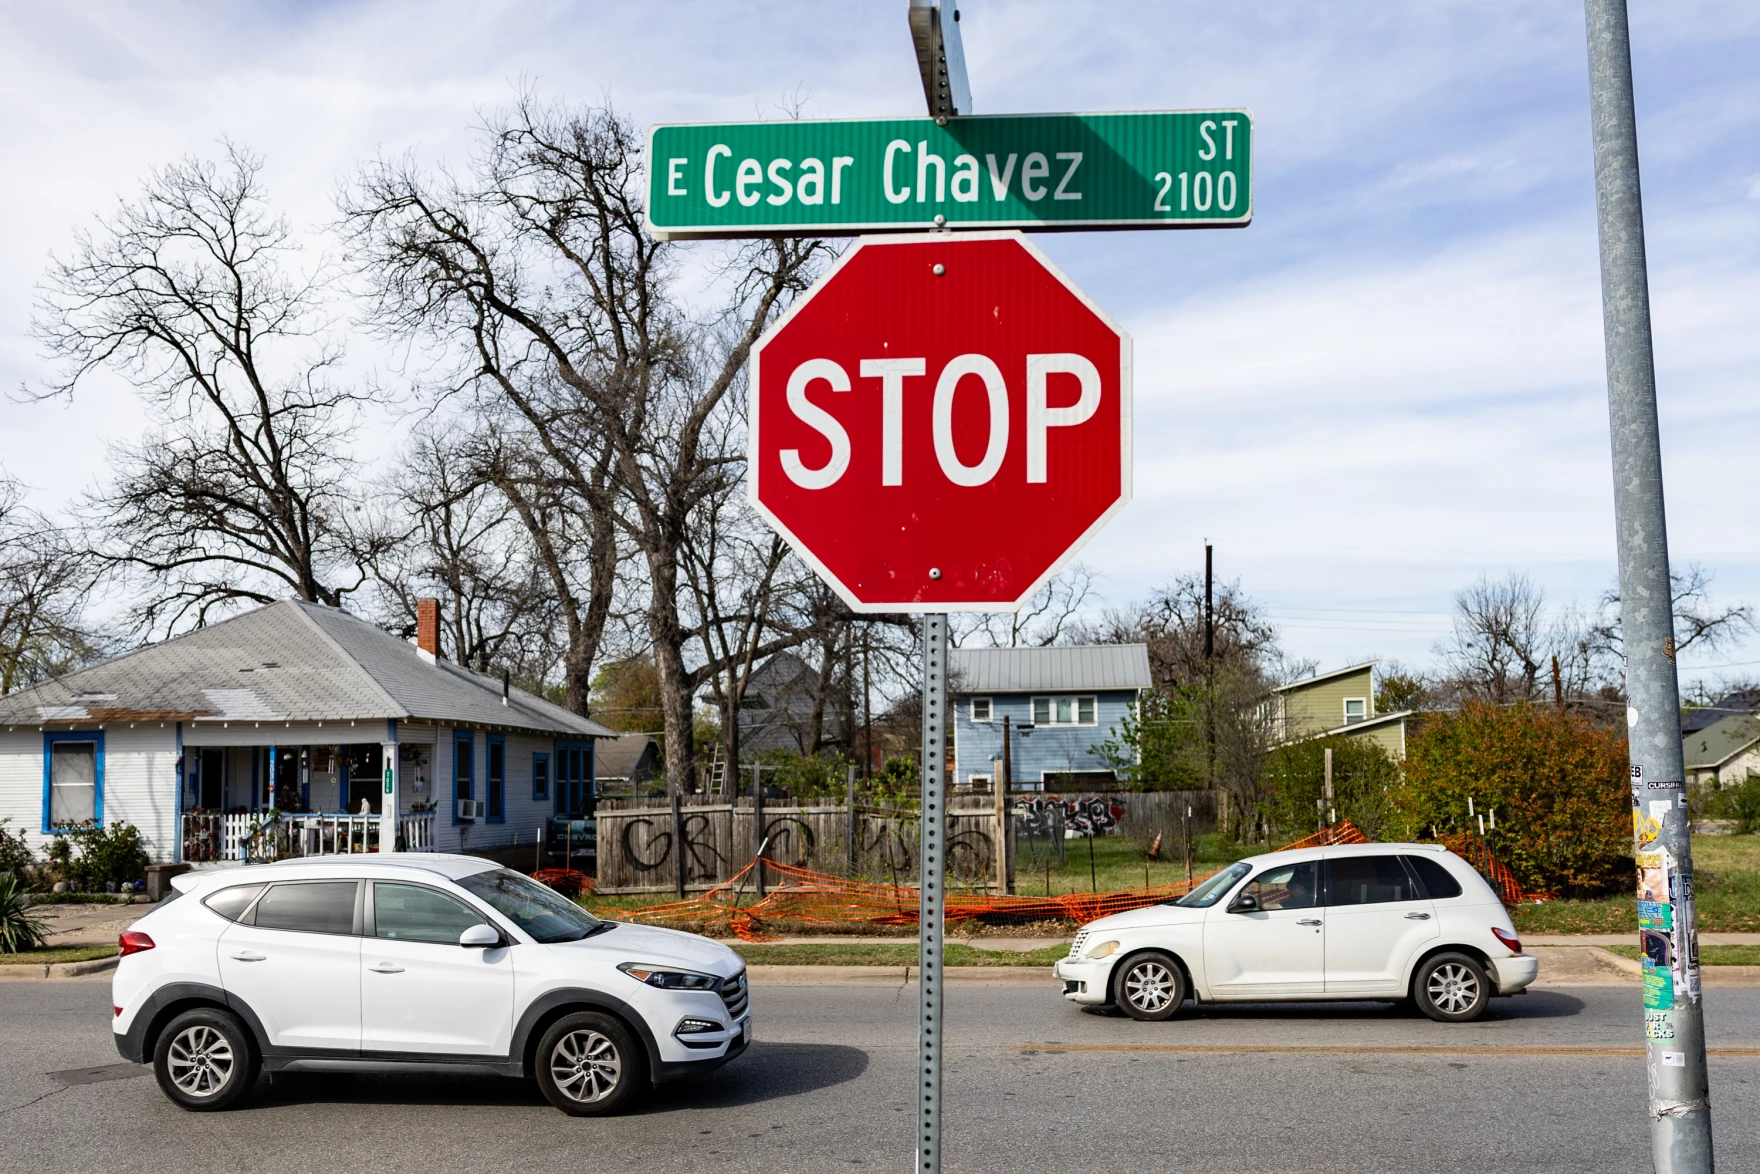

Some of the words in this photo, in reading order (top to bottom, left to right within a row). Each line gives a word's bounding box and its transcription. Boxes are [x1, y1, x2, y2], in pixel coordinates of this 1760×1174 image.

[1198, 120, 1238, 162] ST
[667, 158, 688, 196] E
[705, 143, 854, 208] Cesar
[883, 138, 1083, 205] Chavez
[1154, 169, 1238, 212] 2100
[779, 352, 1102, 490] STOP
[1646, 1030, 1675, 1039] KCKS
